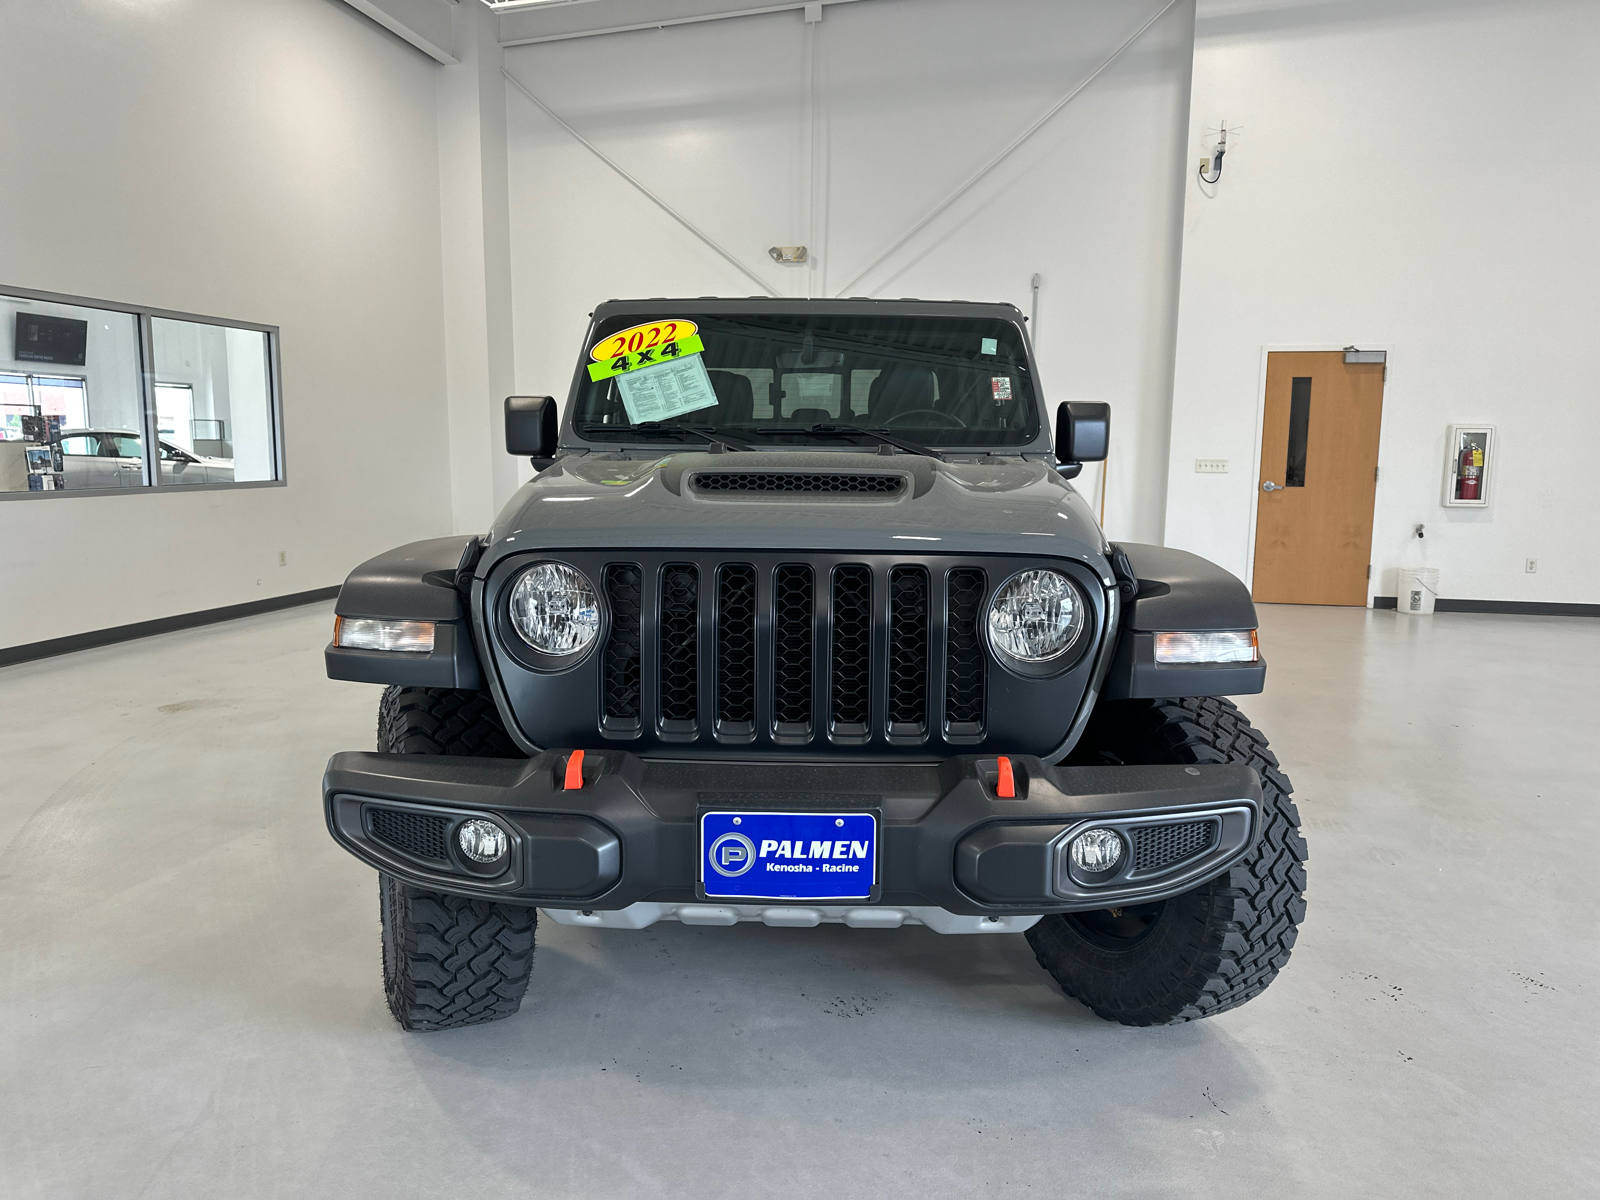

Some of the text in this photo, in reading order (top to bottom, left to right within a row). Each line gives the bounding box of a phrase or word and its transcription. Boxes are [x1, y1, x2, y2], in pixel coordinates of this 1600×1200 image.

[611, 323, 677, 359] 2022
[759, 839, 869, 859] PALMEN
[766, 862, 813, 873] Kenosha
[822, 863, 860, 873] Racine
